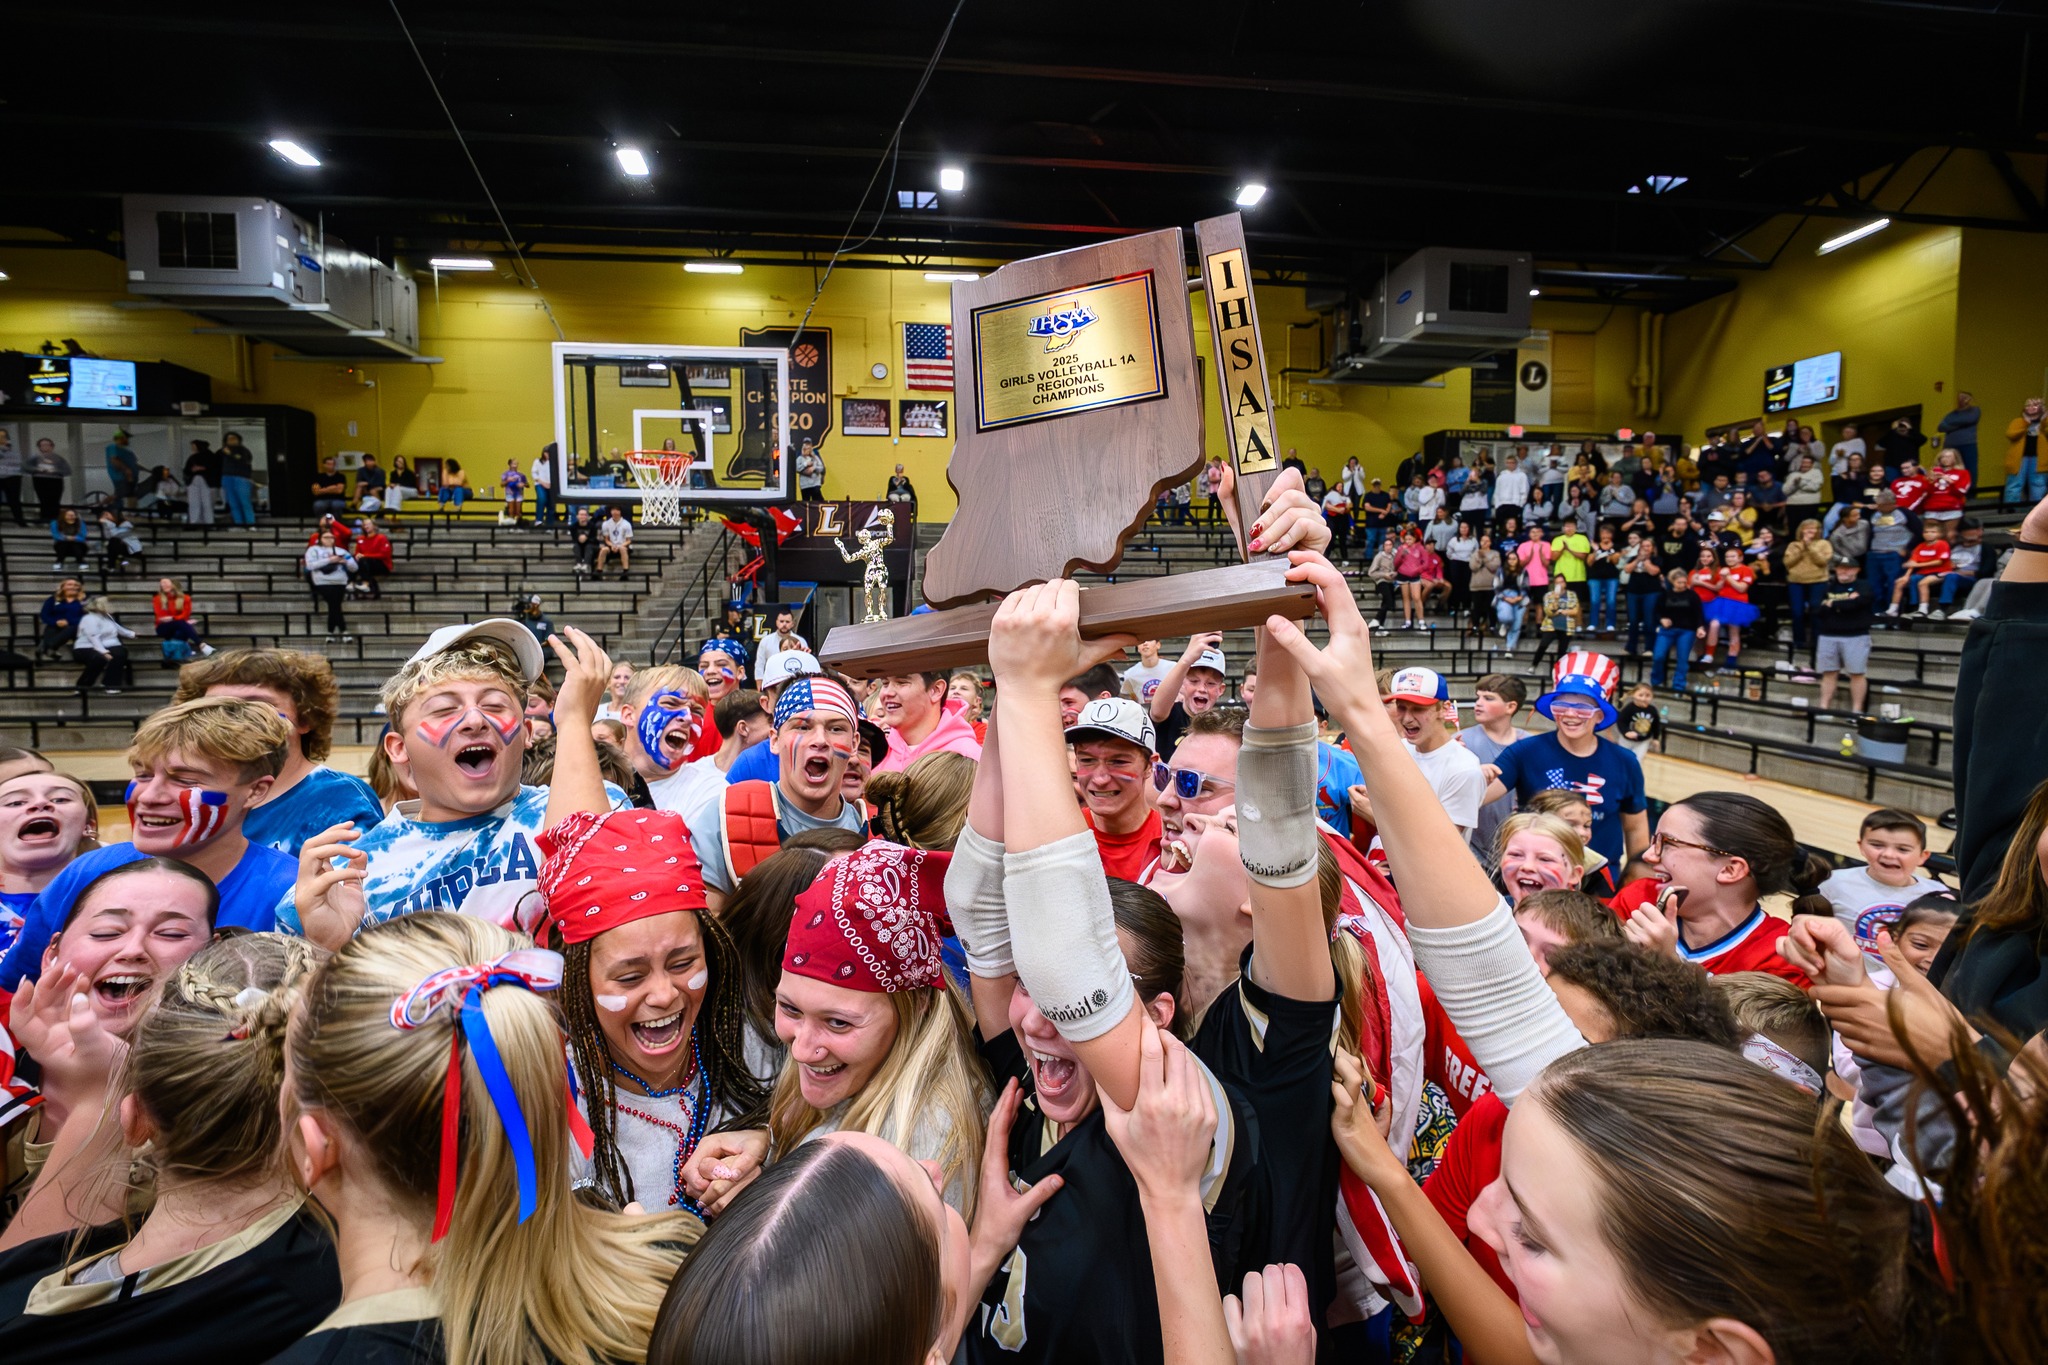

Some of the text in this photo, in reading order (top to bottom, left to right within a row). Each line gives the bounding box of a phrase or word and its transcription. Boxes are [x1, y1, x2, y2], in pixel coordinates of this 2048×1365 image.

[1030, 306, 1098, 335] IHSAA
[1000, 353, 1136, 389] GIRLS VOLLEYBALL 1A
[1052, 353, 1079, 367] 2025
[1217, 260, 1274, 464] IHSAA
[1036, 373, 1099, 393] REGIONAL
[1526, 366, 1543, 385] L
[747, 391, 827, 404] CHAPION
[1032, 383, 1105, 405] CHAMPIONS
[813, 503, 844, 537] L
[753, 614, 772, 642] L
[1445, 1045, 1494, 1103] FREE
